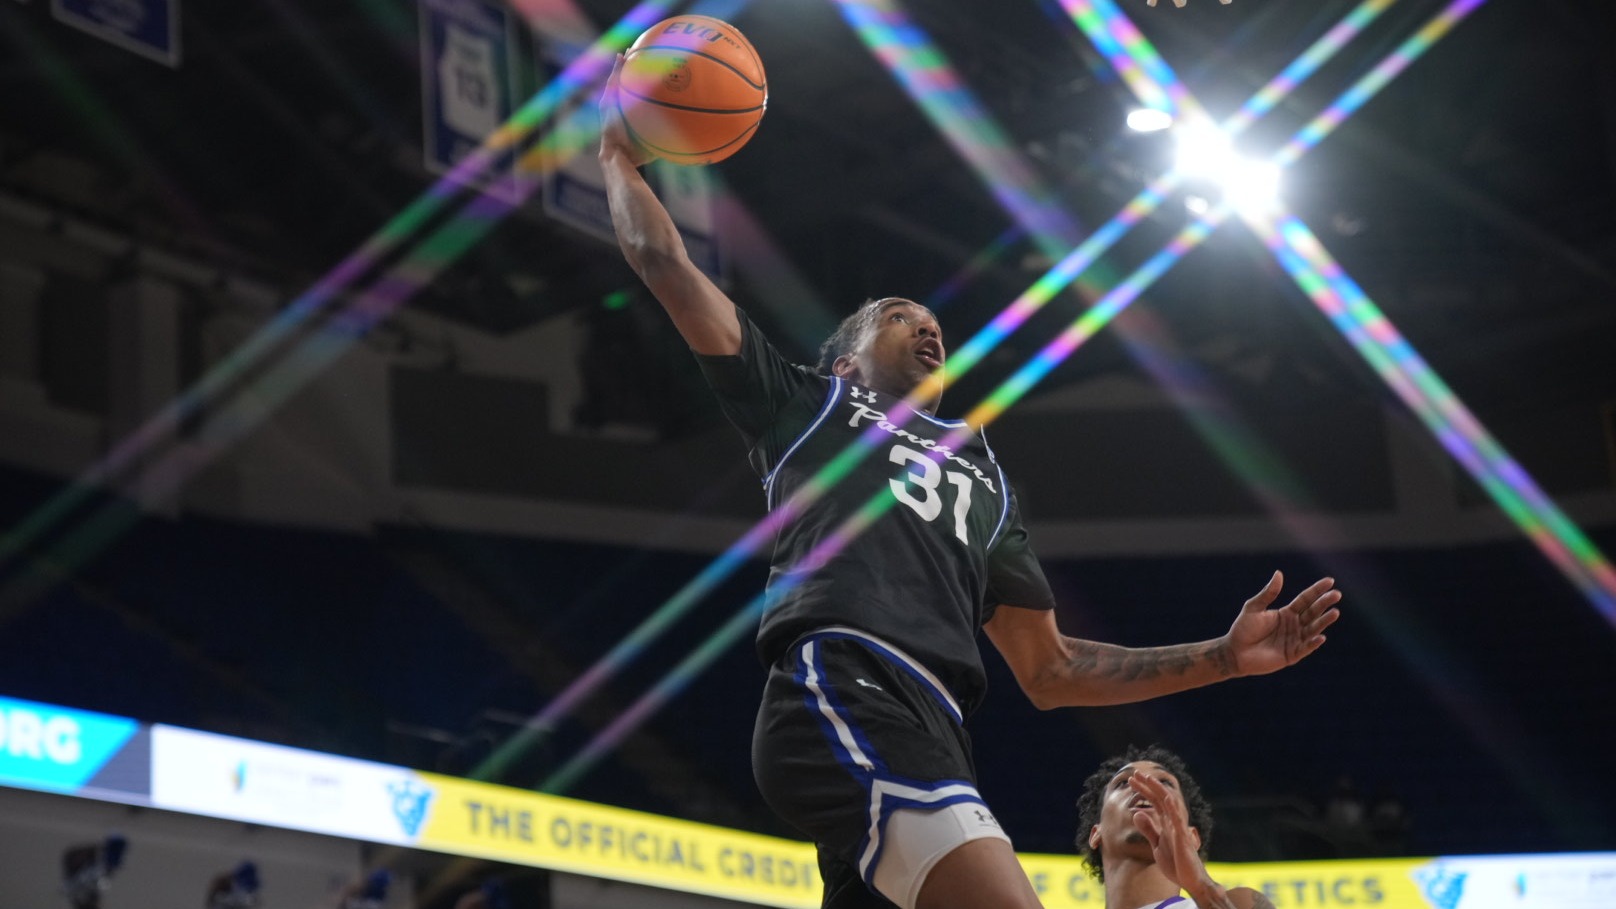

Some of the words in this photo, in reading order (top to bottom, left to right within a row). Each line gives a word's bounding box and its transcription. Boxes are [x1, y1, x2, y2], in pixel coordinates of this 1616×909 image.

[848, 402, 997, 494] Panthers
[889, 444, 973, 546] 31
[0, 708, 81, 764] RG
[465, 800, 534, 843] THE
[550, 817, 706, 873] OFFICIAL
[717, 847, 816, 889] CREDI
[1262, 876, 1386, 906] ETICS
